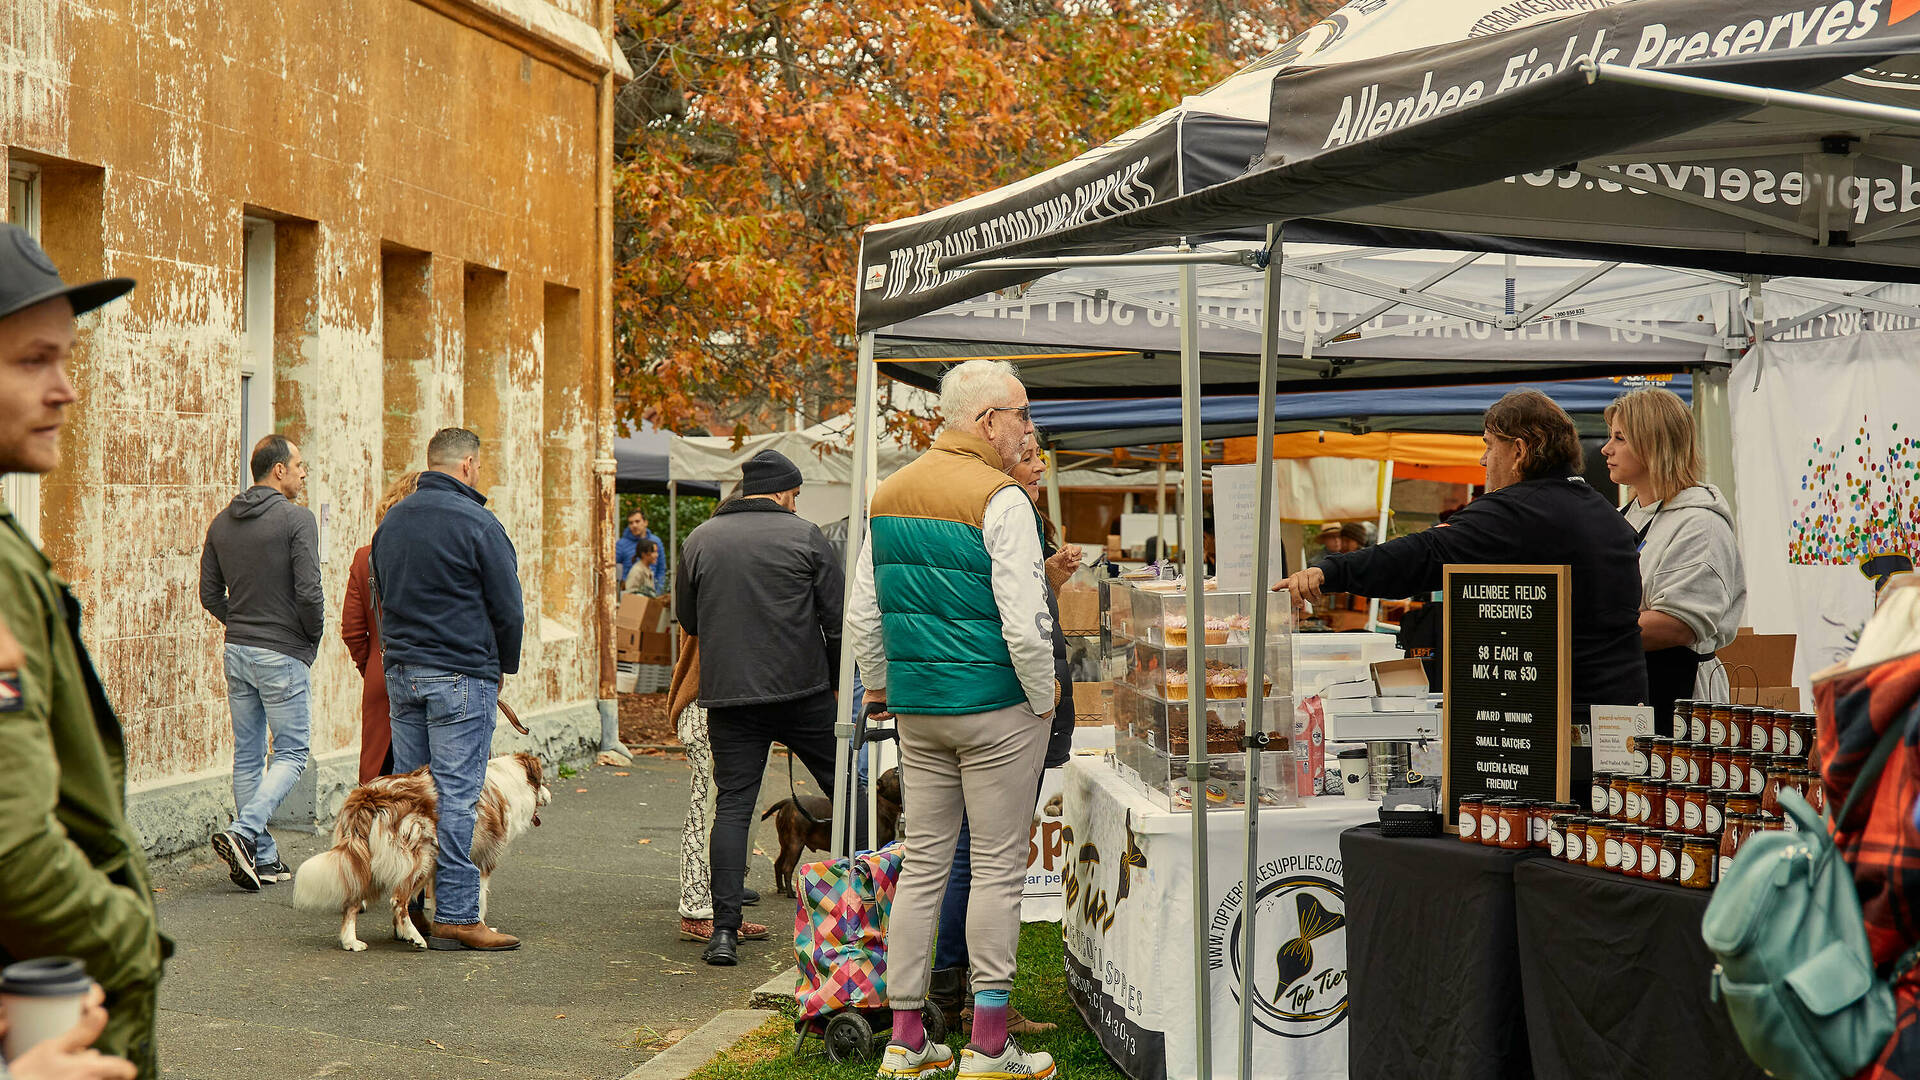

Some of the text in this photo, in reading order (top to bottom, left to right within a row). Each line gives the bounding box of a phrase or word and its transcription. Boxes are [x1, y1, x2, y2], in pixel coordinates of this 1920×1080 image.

[1321, 70, 1486, 150] Allenbee
[1629, 0, 1883, 69] Preserves
[882, 247, 914, 301] TOP
[1462, 584, 1547, 600] ALLENBEE FIELDS
[1478, 603, 1533, 619] PRESERVES
[1478, 645, 1533, 662] $8 EACH OR
[1472, 664, 1537, 681] MIX 4 FOR $30
[1476, 710, 1533, 723] AWARD WINNING
[1475, 735, 1531, 750] SMALL BATCHES
[1476, 761, 1501, 773] GLUTEN
[1507, 763, 1529, 775] VEGAN
[1486, 777, 1518, 791] FRIENDLY
[1285, 967, 1348, 1014] Top Tier
